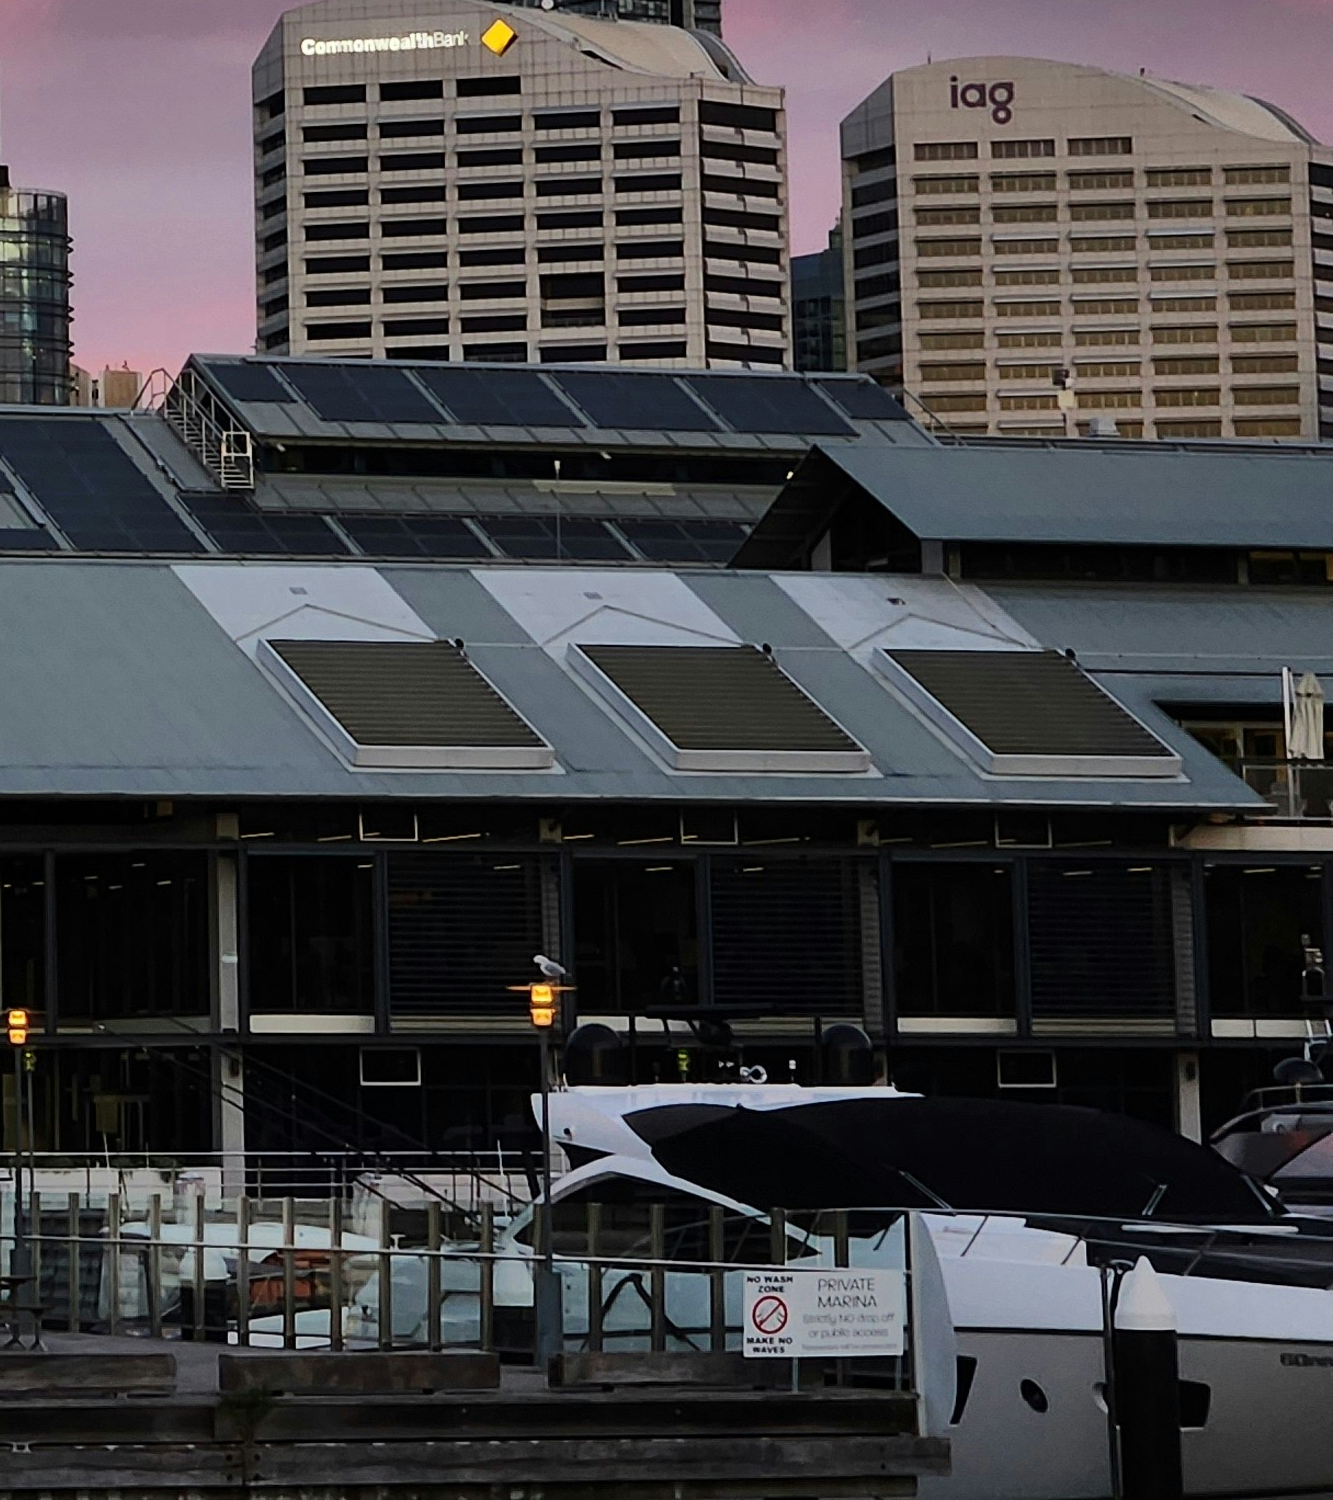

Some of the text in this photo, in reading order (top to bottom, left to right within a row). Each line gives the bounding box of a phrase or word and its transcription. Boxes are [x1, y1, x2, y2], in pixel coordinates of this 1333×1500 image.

[300, 30, 469, 56] CommonwealthBank
[949, 75, 1015, 125] iag
[817, 1278, 875, 1292] PRIVATE
[817, 1295, 877, 1308] MARINA
[752, 1346, 785, 1354] WAVES
